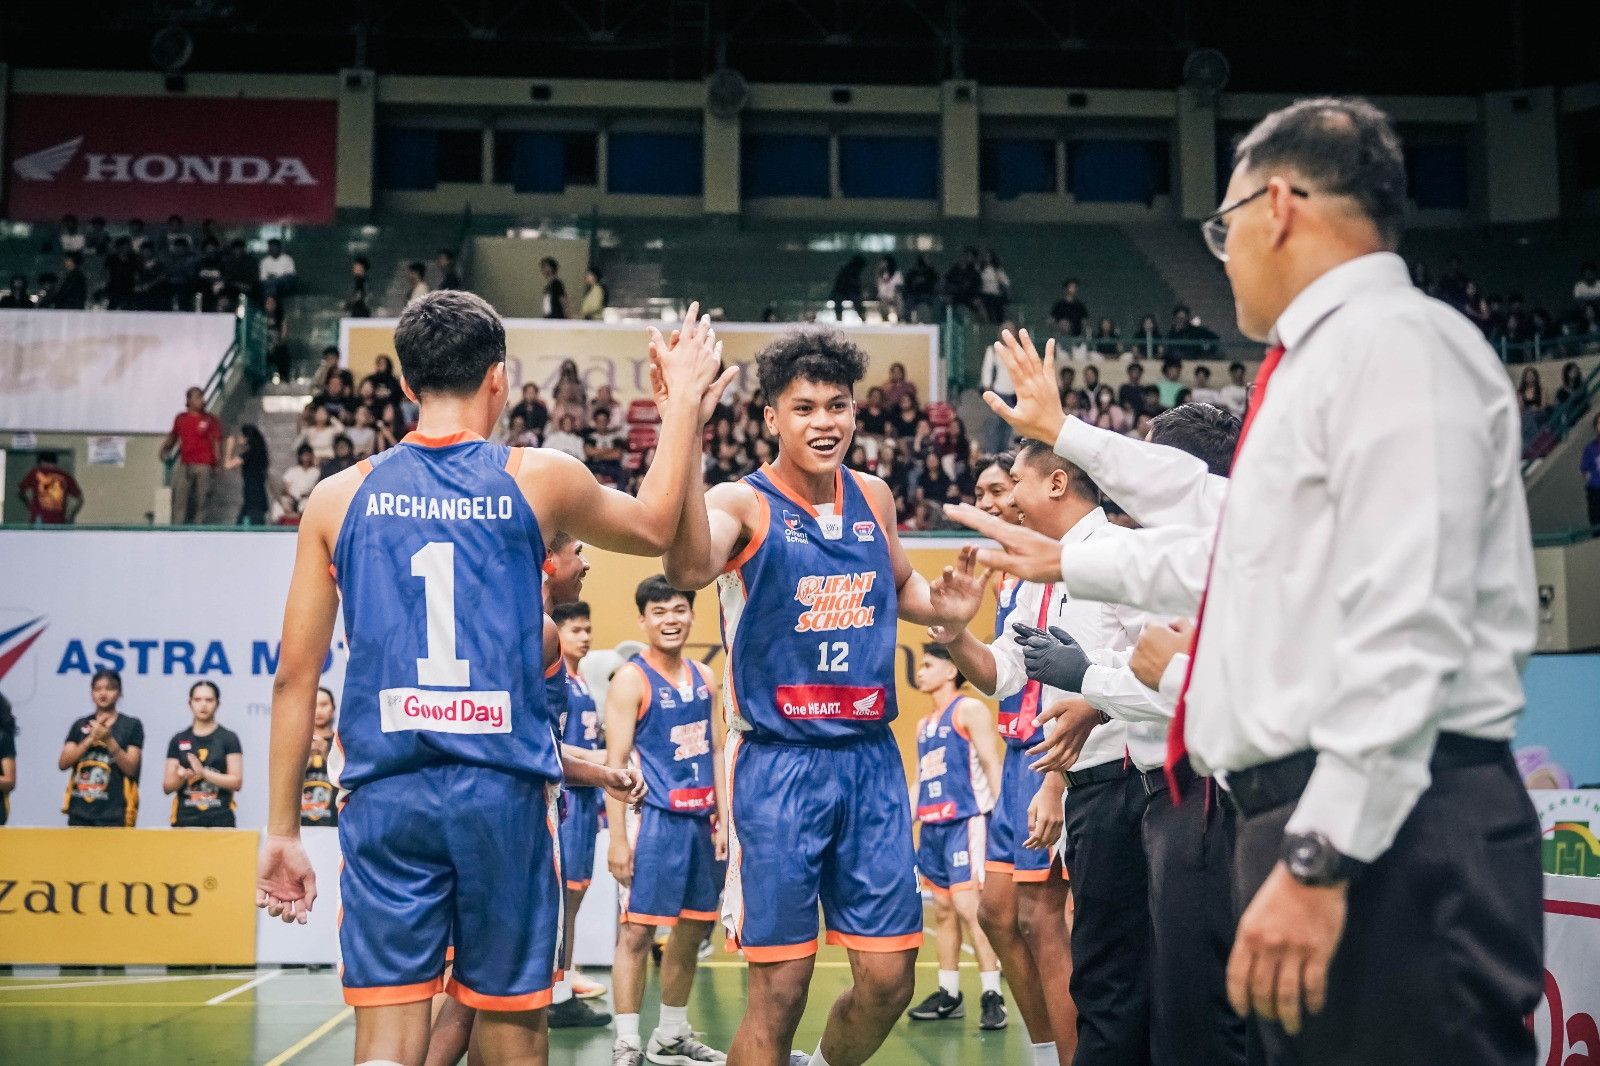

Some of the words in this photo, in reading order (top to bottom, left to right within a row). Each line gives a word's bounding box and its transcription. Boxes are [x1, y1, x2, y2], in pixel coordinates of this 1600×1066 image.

[83, 153, 319, 186] HONDA
[366, 492, 513, 520] ARCHANGELO
[410, 541, 471, 688] 1
[811, 592, 864, 613] HIGH
[794, 605, 876, 633] SCHOOL
[57, 639, 232, 675] ASTRA
[817, 641, 849, 672] 12
[403, 695, 457, 721] Good
[461, 699, 503, 727] Day
[783, 702, 807, 716] One
